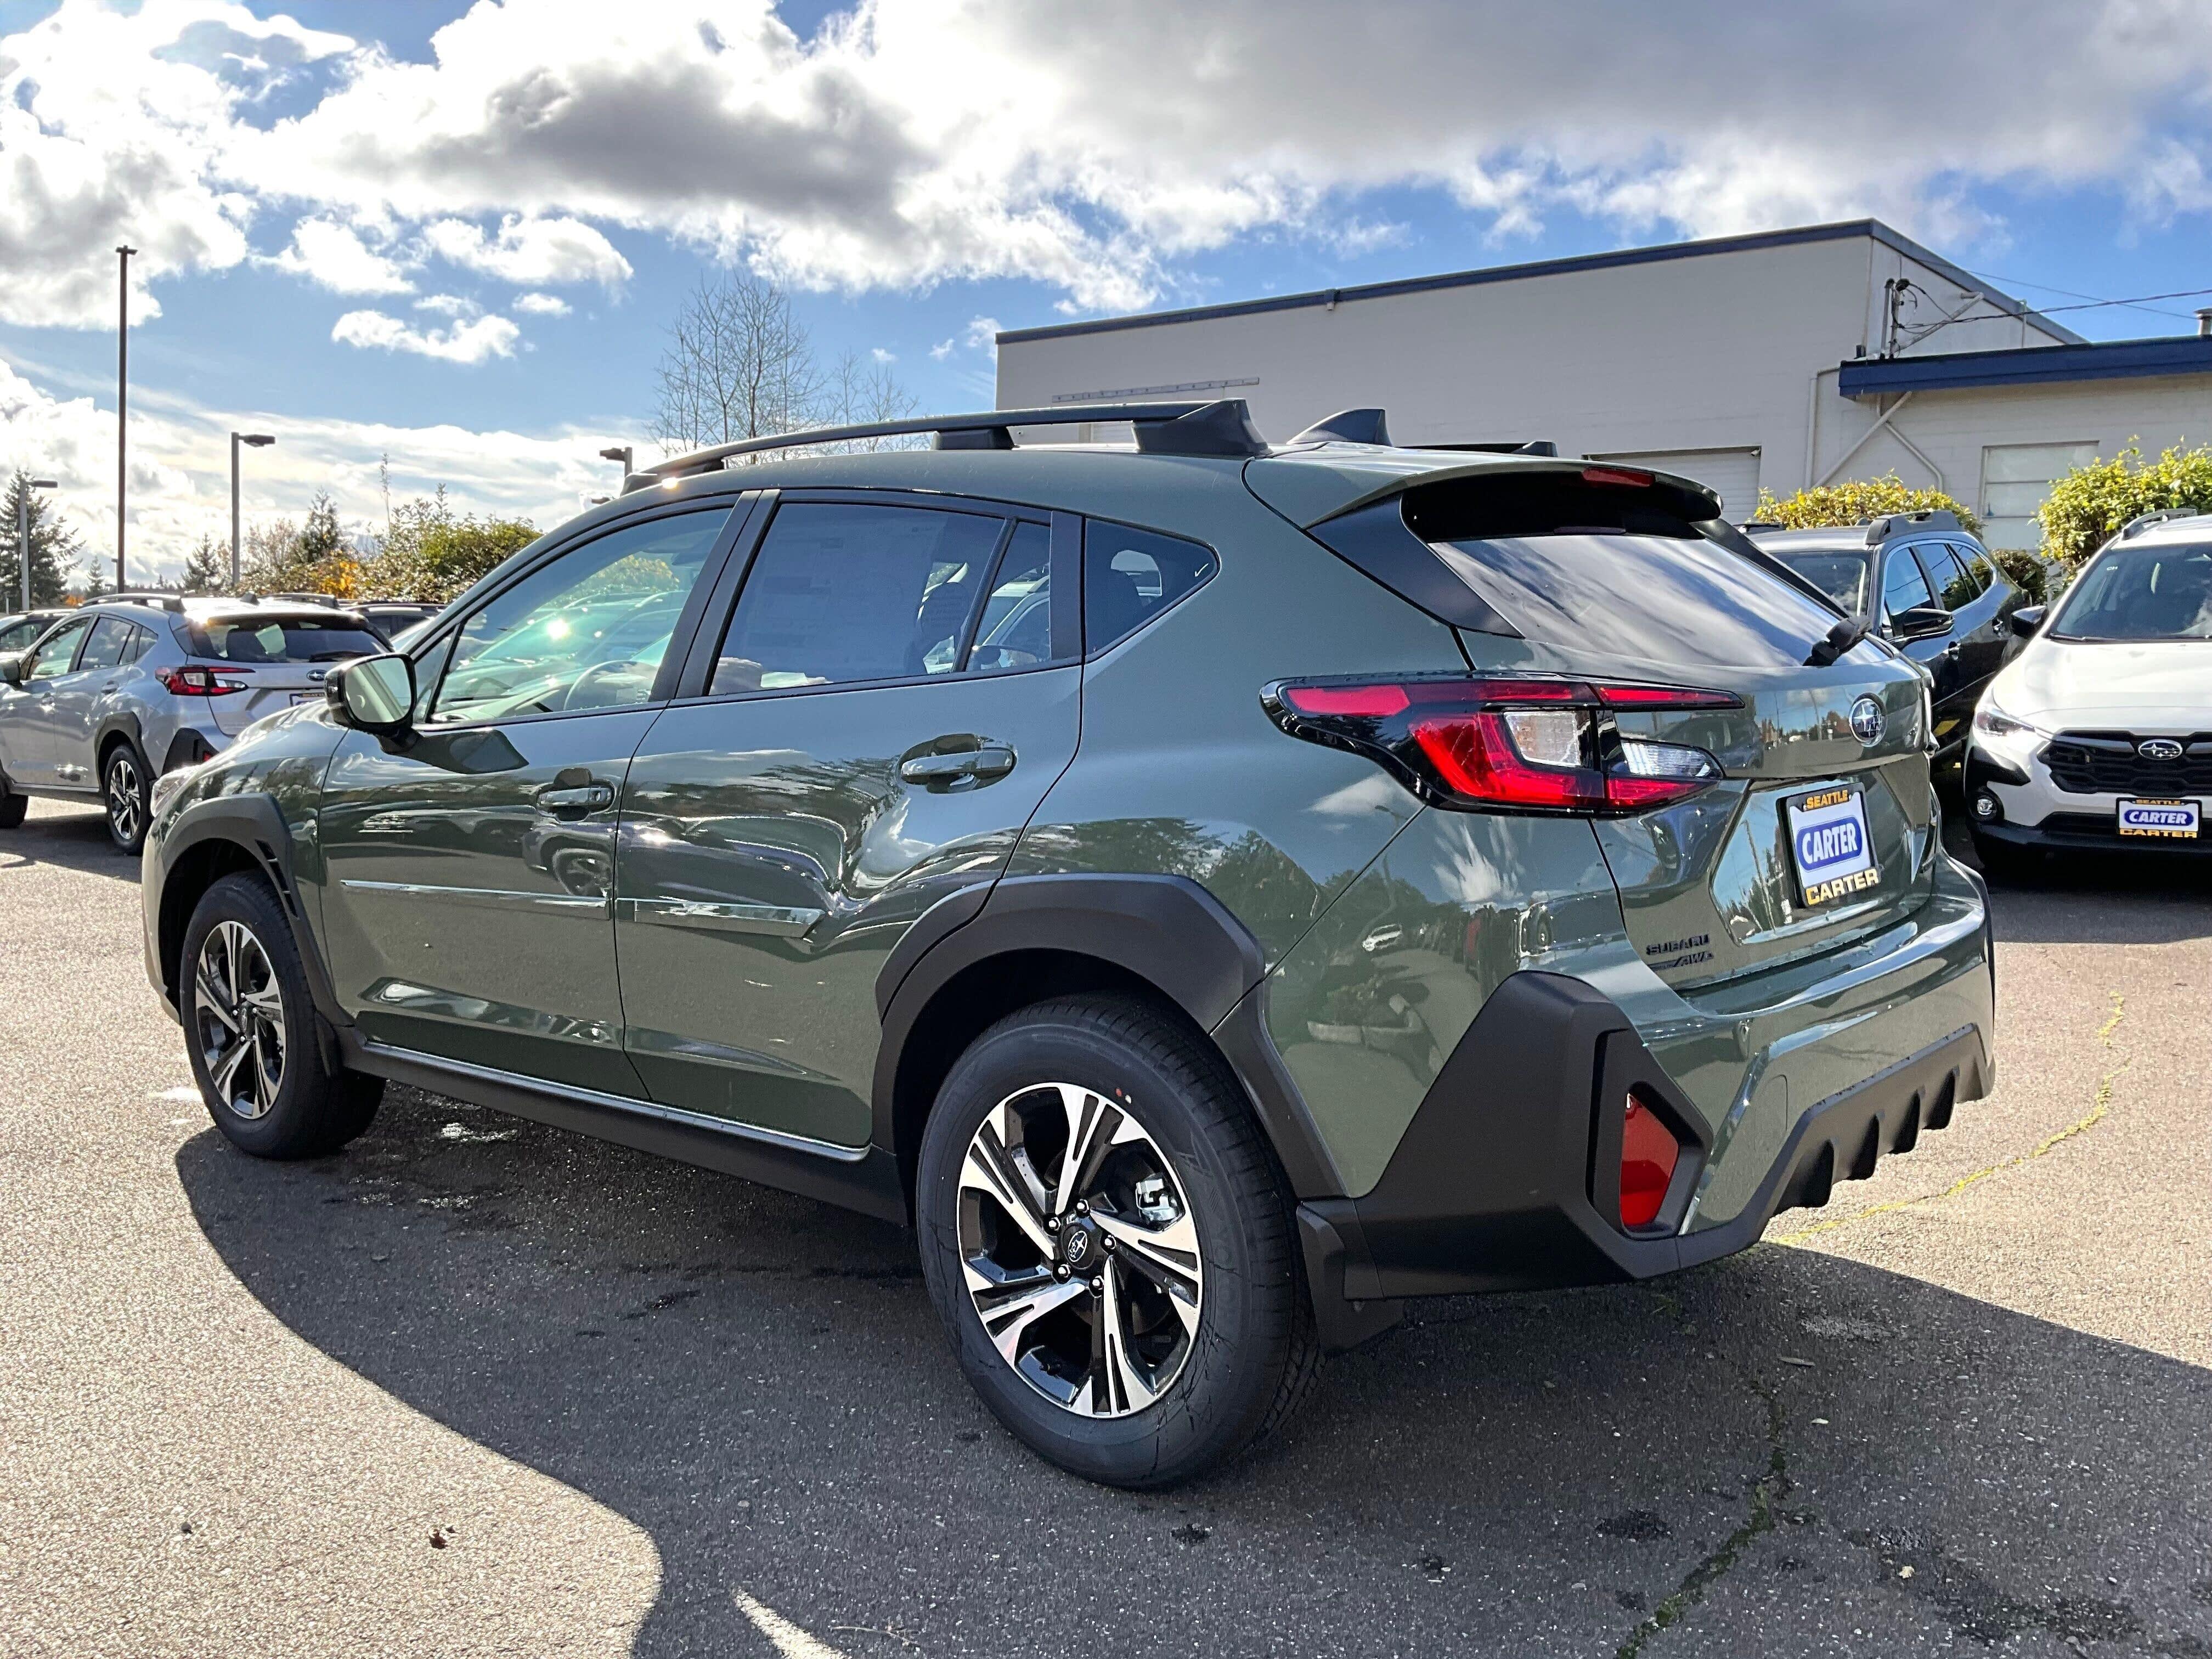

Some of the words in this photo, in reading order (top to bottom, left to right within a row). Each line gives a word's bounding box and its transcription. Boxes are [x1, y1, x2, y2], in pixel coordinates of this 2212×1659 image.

[1806, 789, 1848, 810] SEATTLE
[2129, 811, 2187, 824] CARTER
[1802, 823, 1858, 864] CARTER
[2120, 828, 2197, 838] CARTER
[1805, 868, 1880, 905] CARTER
[1646, 934, 1710, 955] SUBARU
